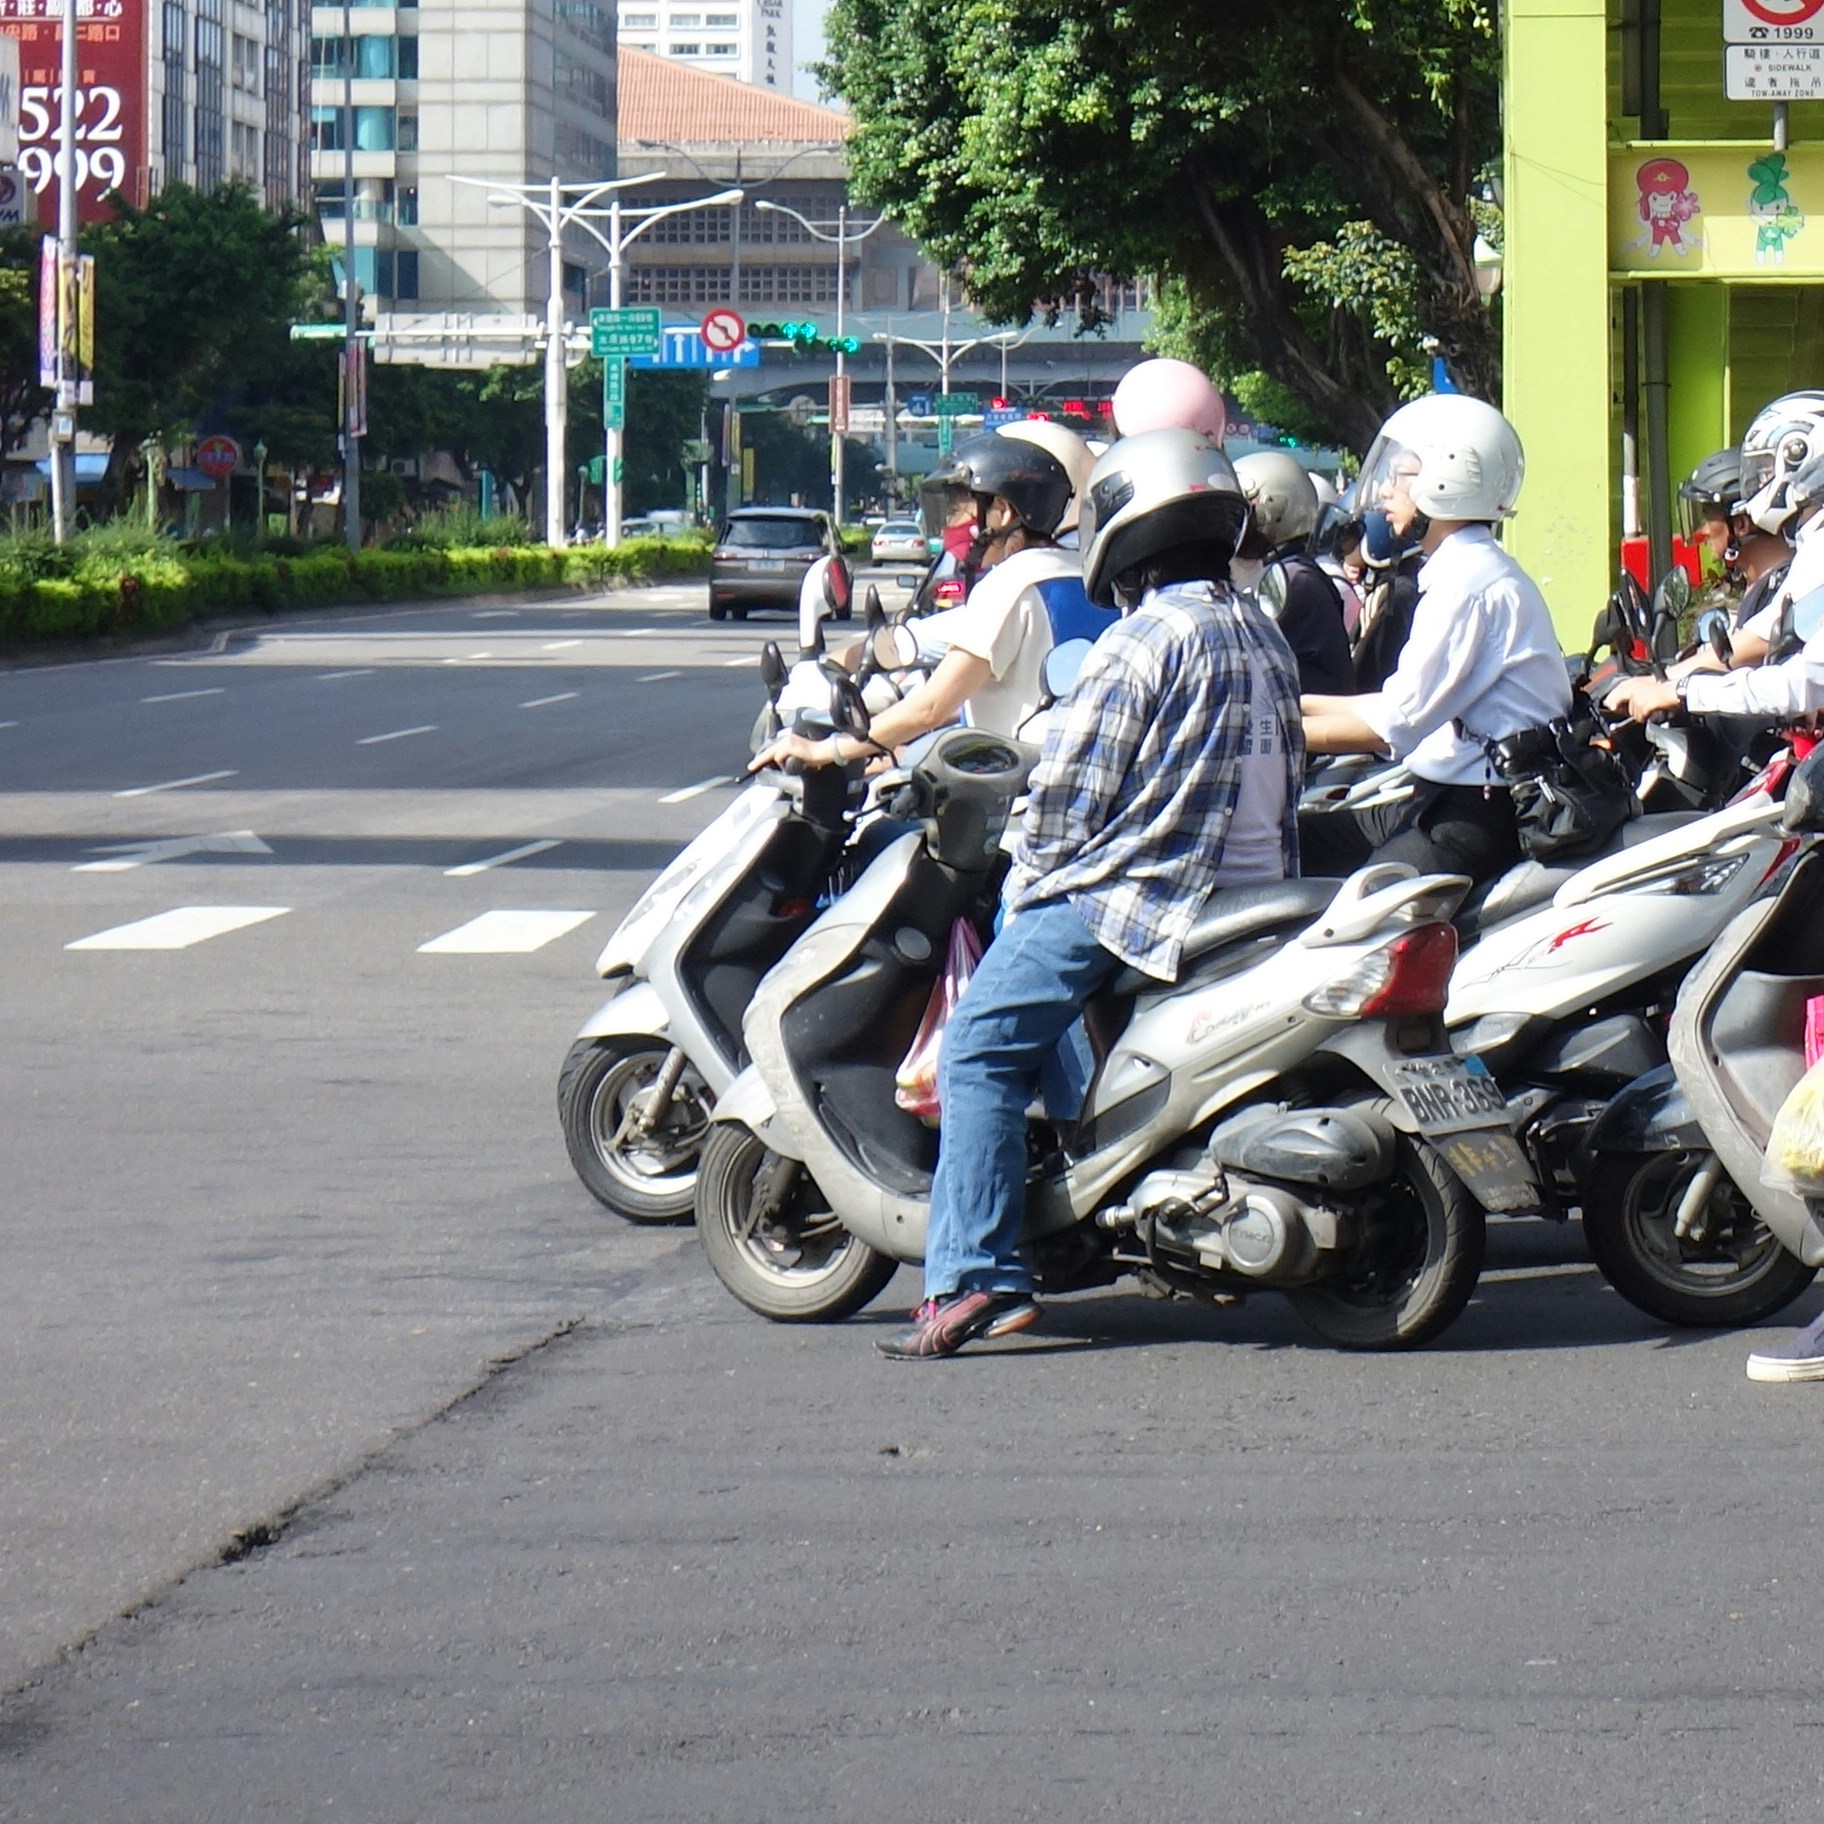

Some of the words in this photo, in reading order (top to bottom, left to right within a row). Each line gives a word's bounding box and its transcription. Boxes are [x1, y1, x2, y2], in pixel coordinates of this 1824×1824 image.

[1773, 27, 1814, 39] 1999
[1768, 64, 1812, 72] SIDEWALK
[1794, 89, 1815, 98] ZONE
[1400, 1076, 1506, 1123] BNR-369
